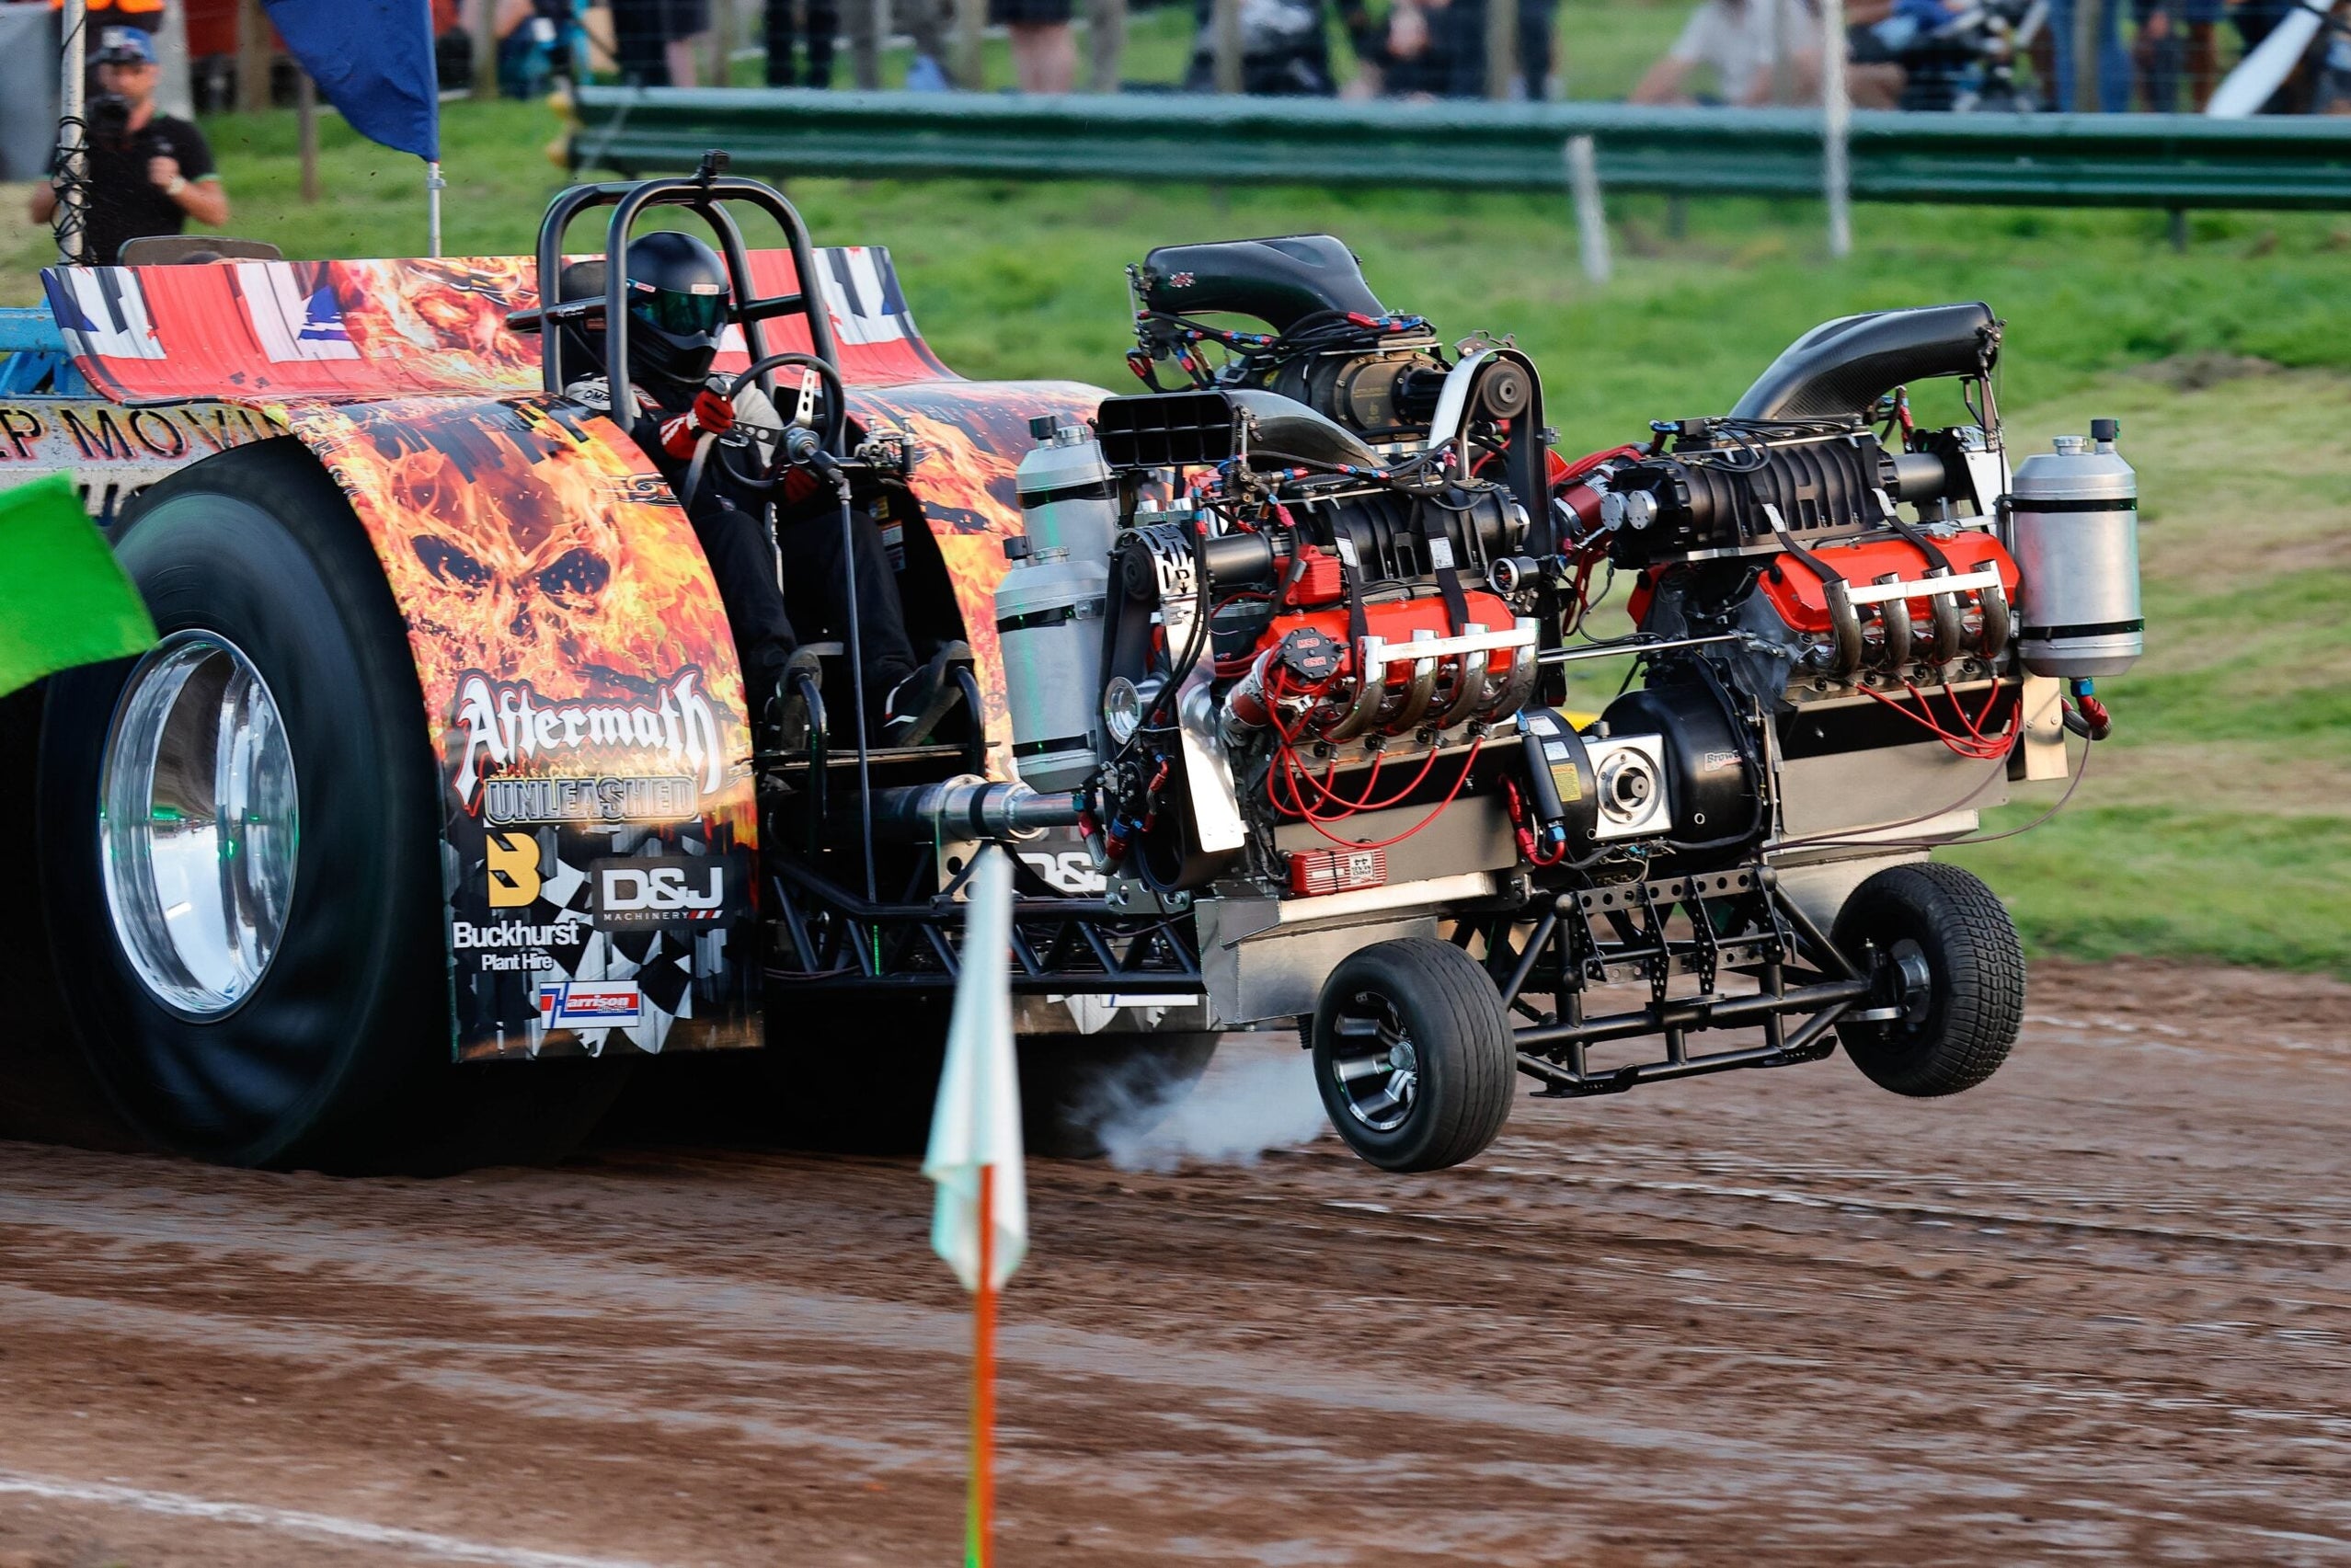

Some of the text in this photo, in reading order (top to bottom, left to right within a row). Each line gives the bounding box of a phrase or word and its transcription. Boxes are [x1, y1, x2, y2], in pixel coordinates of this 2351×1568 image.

[453, 673, 722, 805] Aftermath
[487, 780, 696, 820] UNLEASHED
[602, 866, 724, 910] D&J
[603, 910, 689, 921] MACHINERY
[453, 920, 579, 948] Buckhurst
[481, 953, 553, 971] Plant Hire
